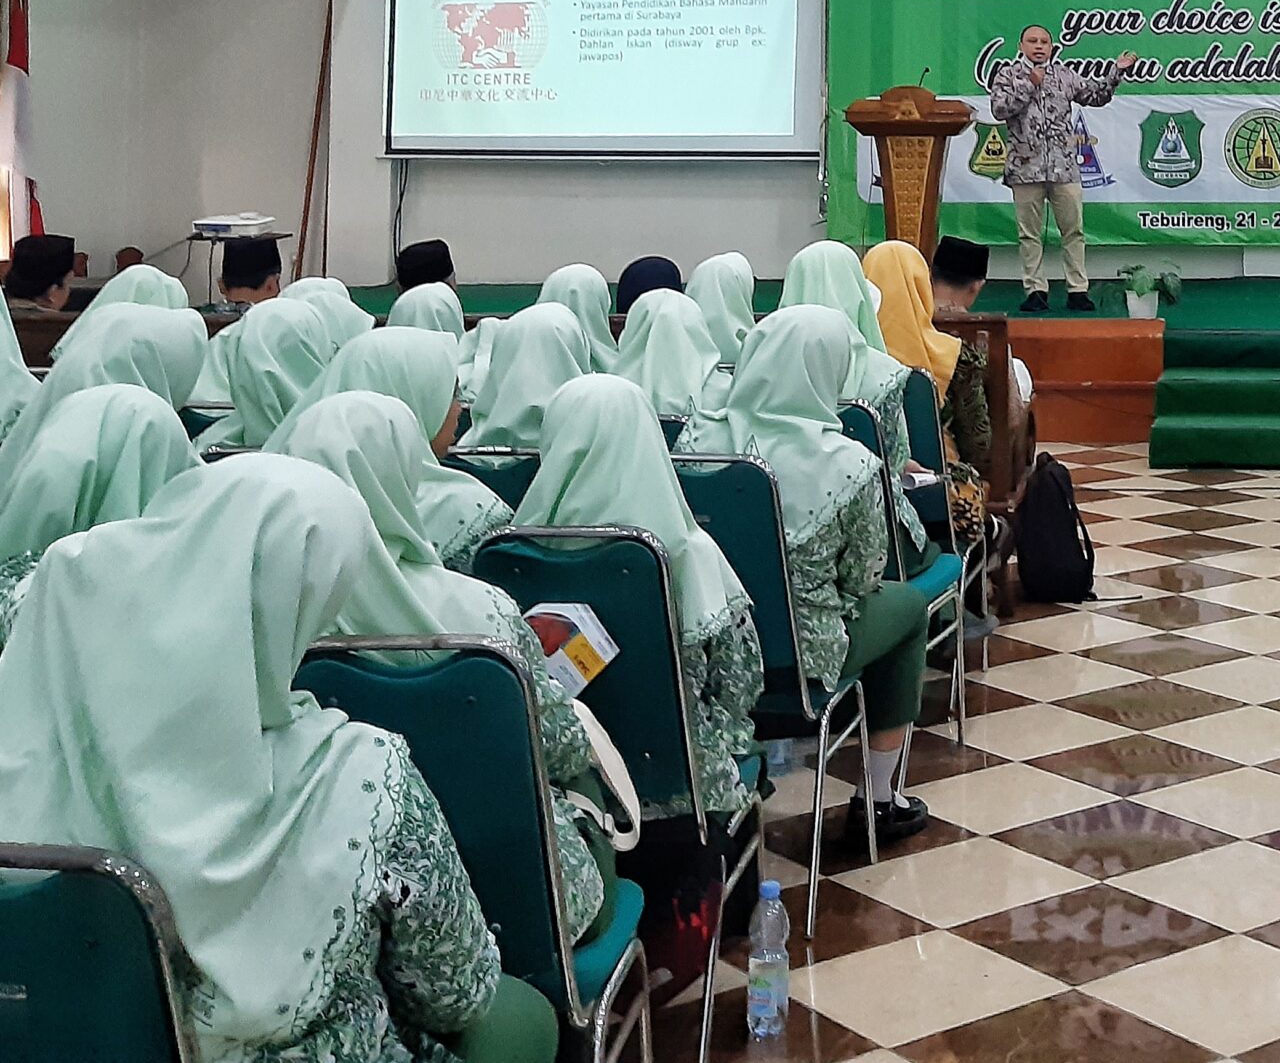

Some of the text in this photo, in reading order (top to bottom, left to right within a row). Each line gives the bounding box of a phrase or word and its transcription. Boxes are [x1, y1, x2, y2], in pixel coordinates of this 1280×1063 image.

[580, 0, 619, 11] Yayasan
[580, 10, 682, 22] pertama di Surabaya
[580, 27, 624, 38] Didirikan
[627, 27, 652, 39] pada
[656, 27, 685, 36] tahun
[689, 26, 714, 36] 2001
[719, 25, 741, 35] oleh
[1062, 6, 1144, 45] your
[579, 39, 614, 49] Dahlan
[665, 37, 703, 49] (disway
[715, 39, 739, 49] grup
[751, 38, 766, 47] ex:
[447, 72, 531, 85] ITC CENTRE
[1139, 212, 1231, 230] Tebuireng,
[1236, 212, 1256, 228] 21
